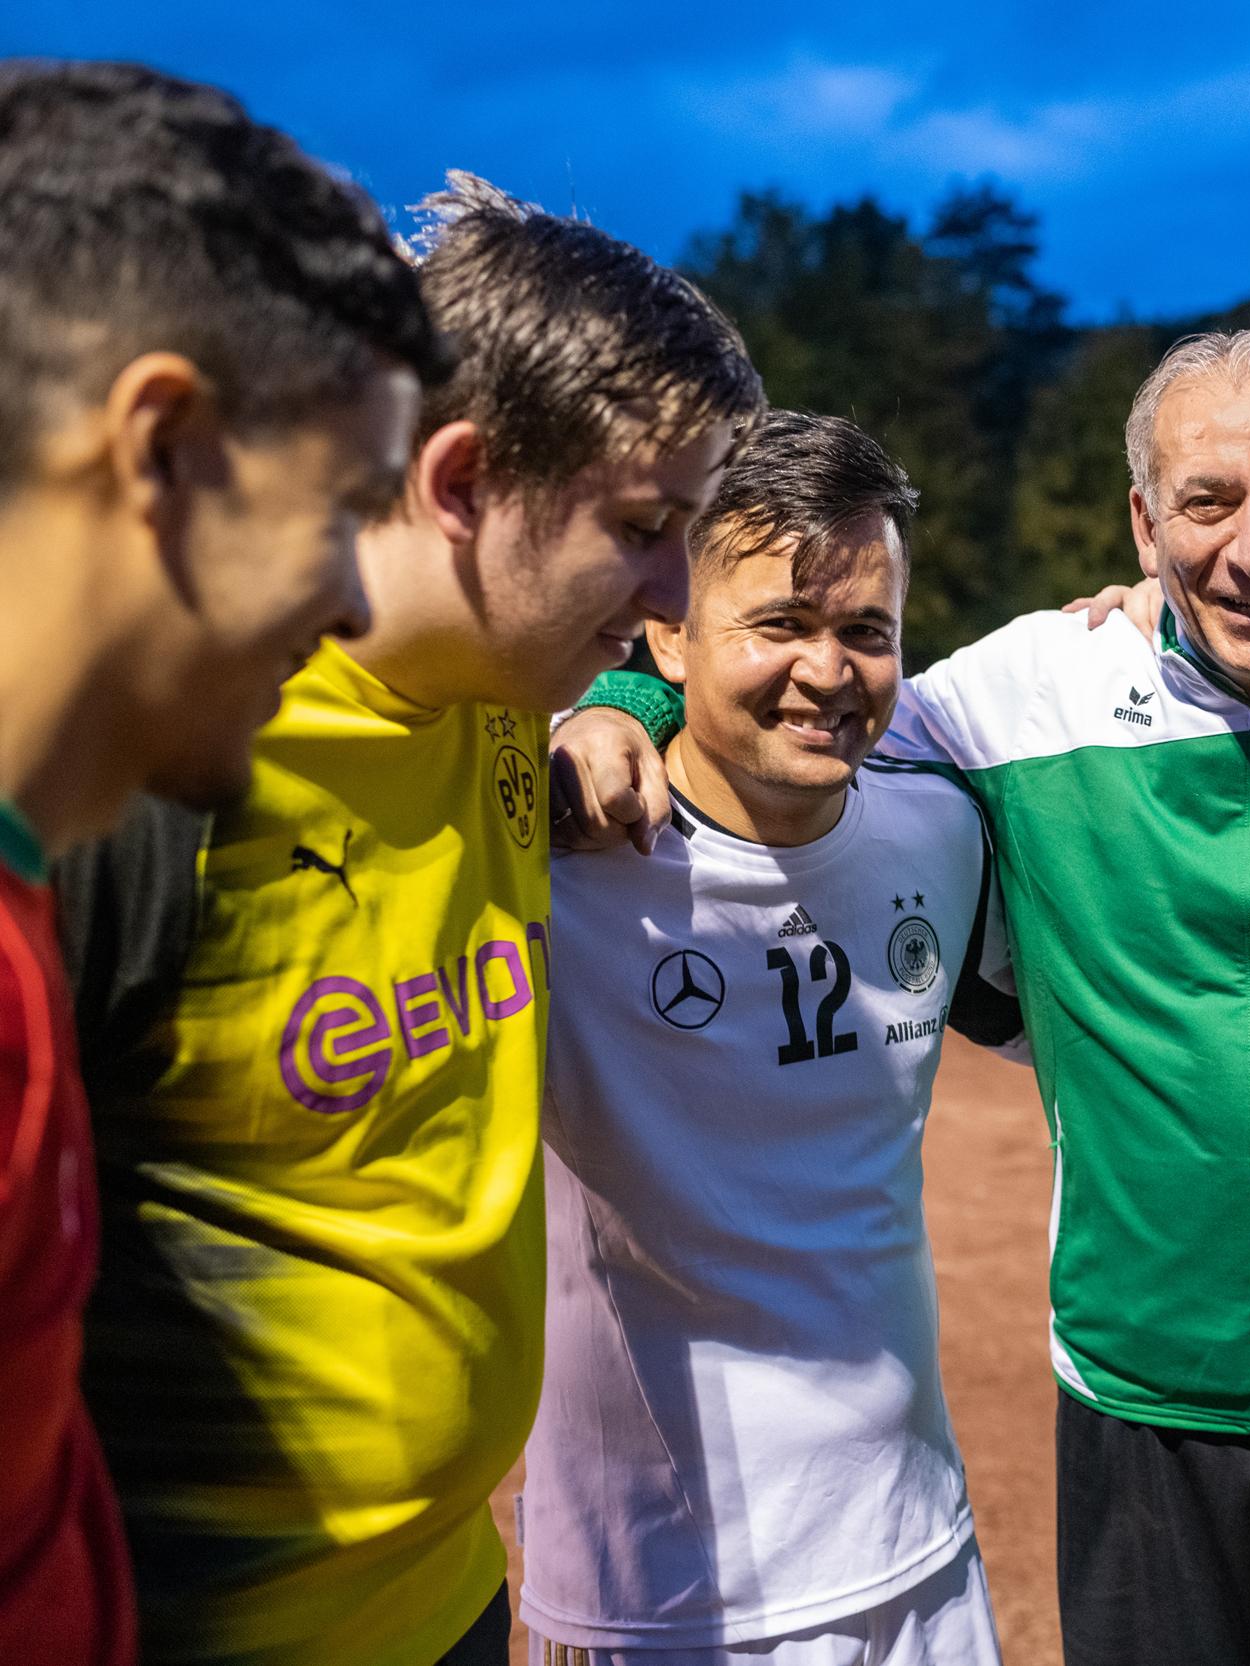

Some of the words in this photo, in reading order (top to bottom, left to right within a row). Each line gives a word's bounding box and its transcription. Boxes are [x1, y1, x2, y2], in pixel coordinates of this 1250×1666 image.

[1113, 706, 1153, 728] erima
[498, 754, 535, 819] BVB
[777, 923, 818, 938] adidas
[393, 913, 552, 1060] EVON
[766, 940, 858, 1066] 12
[884, 1018, 937, 1046] Allianz
